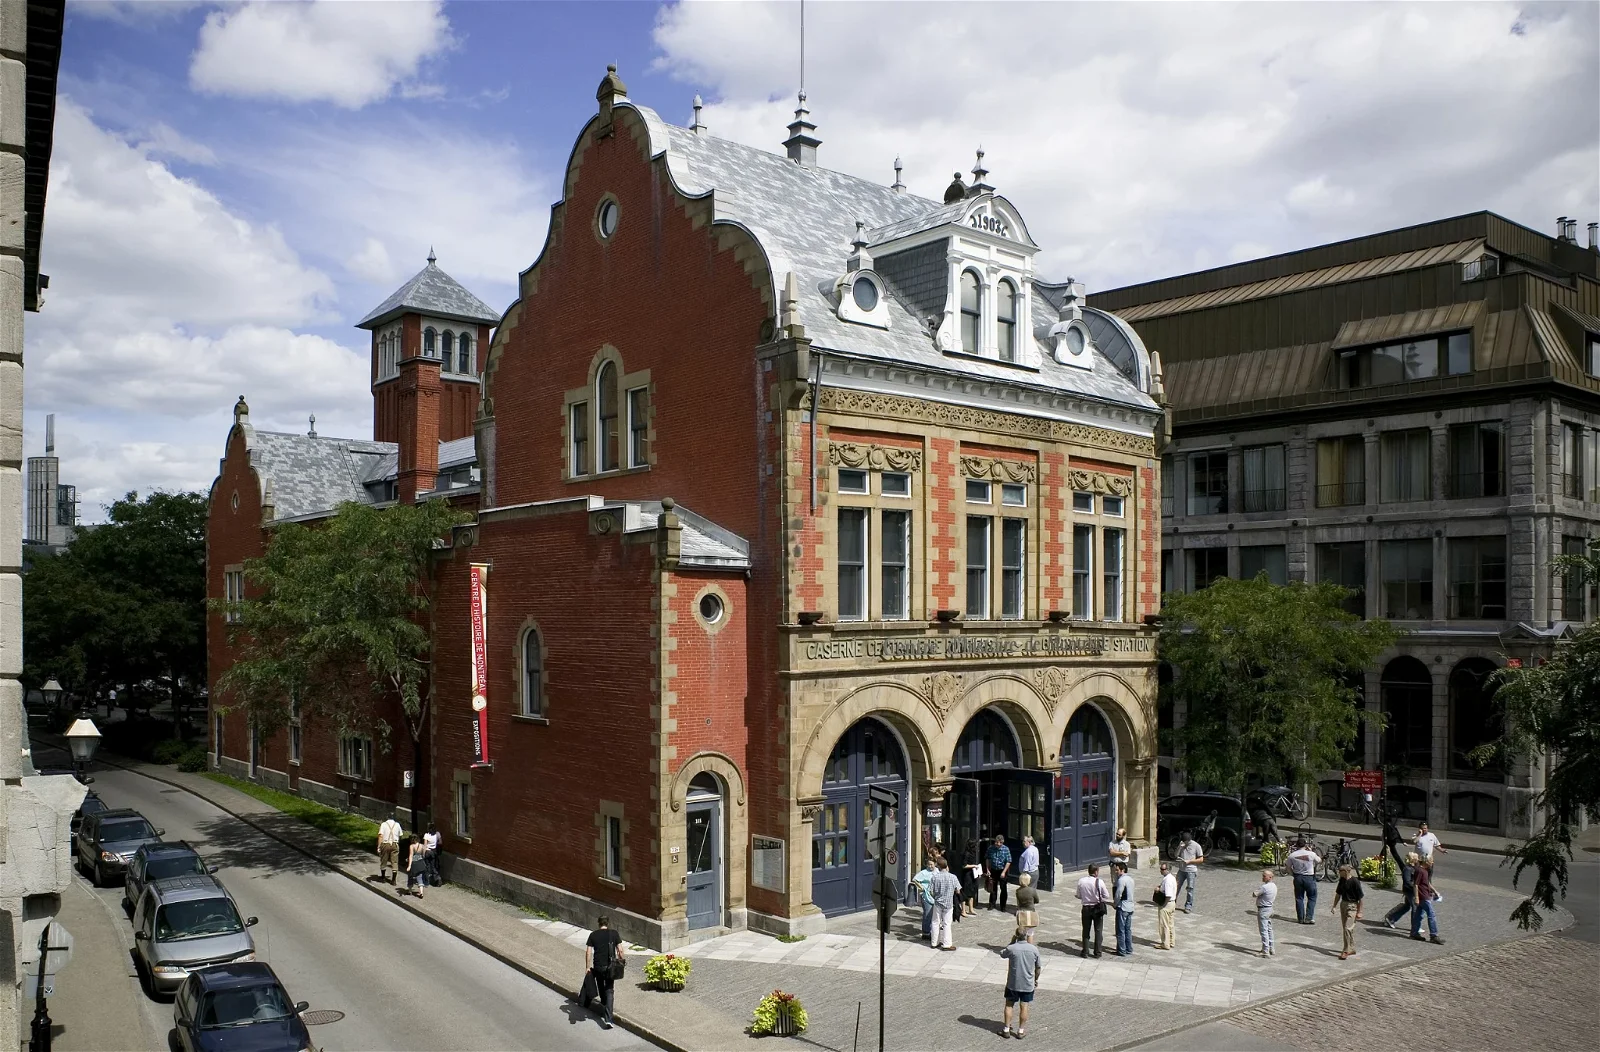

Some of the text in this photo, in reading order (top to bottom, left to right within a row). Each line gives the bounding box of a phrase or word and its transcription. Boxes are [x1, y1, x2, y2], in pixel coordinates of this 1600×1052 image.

[471, 572, 479, 601] CENTRE
[475, 643, 483, 653] DE
[806, 640, 864, 660] CASERNE
[1113, 637, 1150, 652] STATION
[476, 654, 487, 692] MONTRÉAL
[472, 719, 480, 756] EXPOSITIONS
